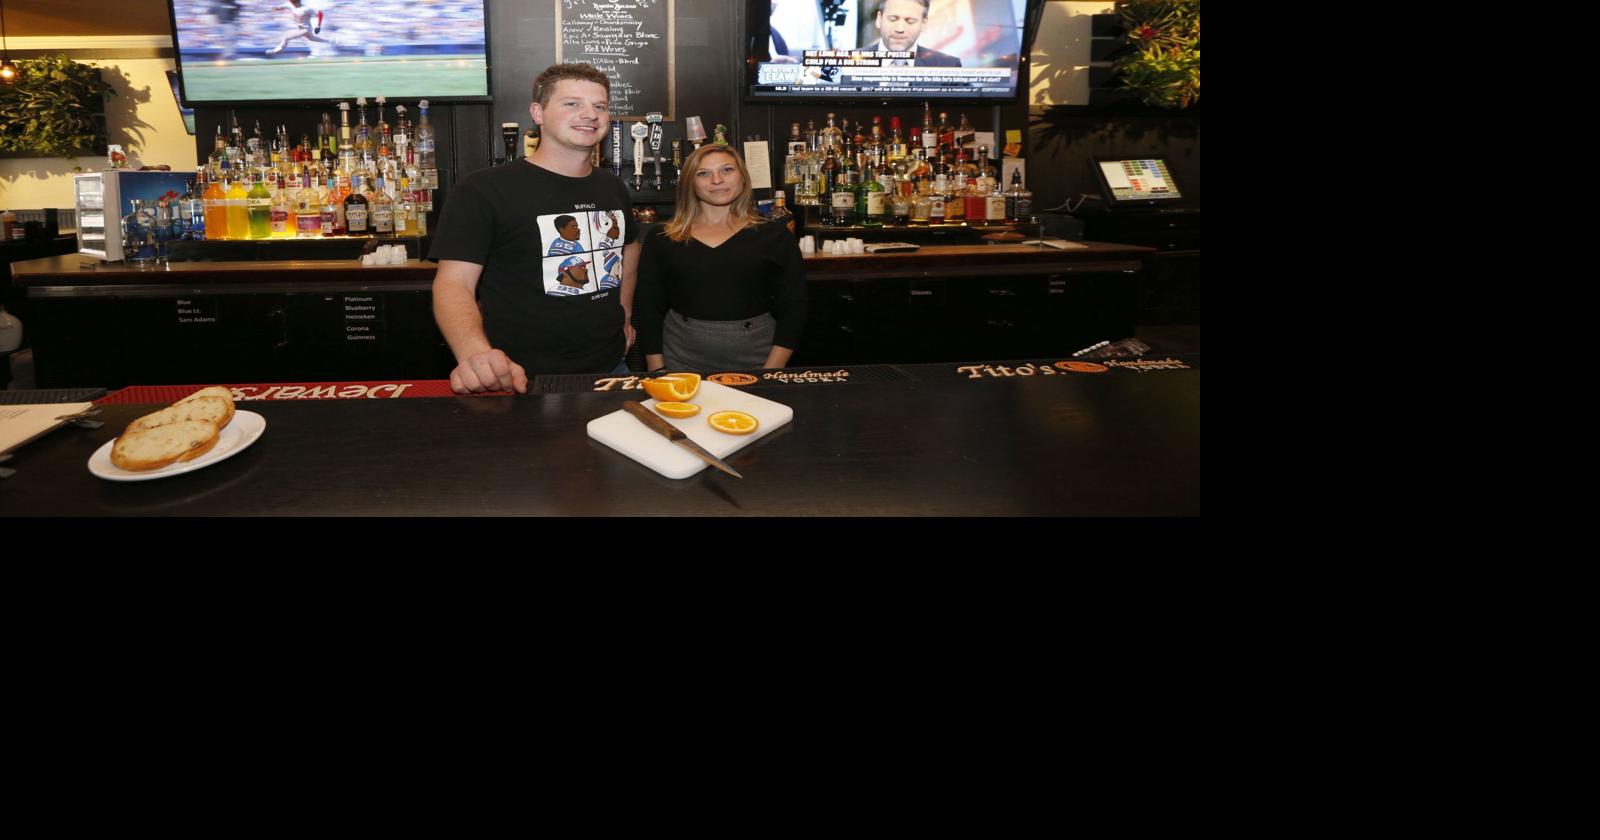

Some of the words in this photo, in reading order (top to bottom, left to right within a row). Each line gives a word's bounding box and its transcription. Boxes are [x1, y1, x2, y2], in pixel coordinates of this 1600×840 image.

[584, 44, 599, 52] Red
[613, 126, 621, 147] LIGHT
[613, 147, 621, 163] BUD
[763, 369, 849, 380] Handmade
